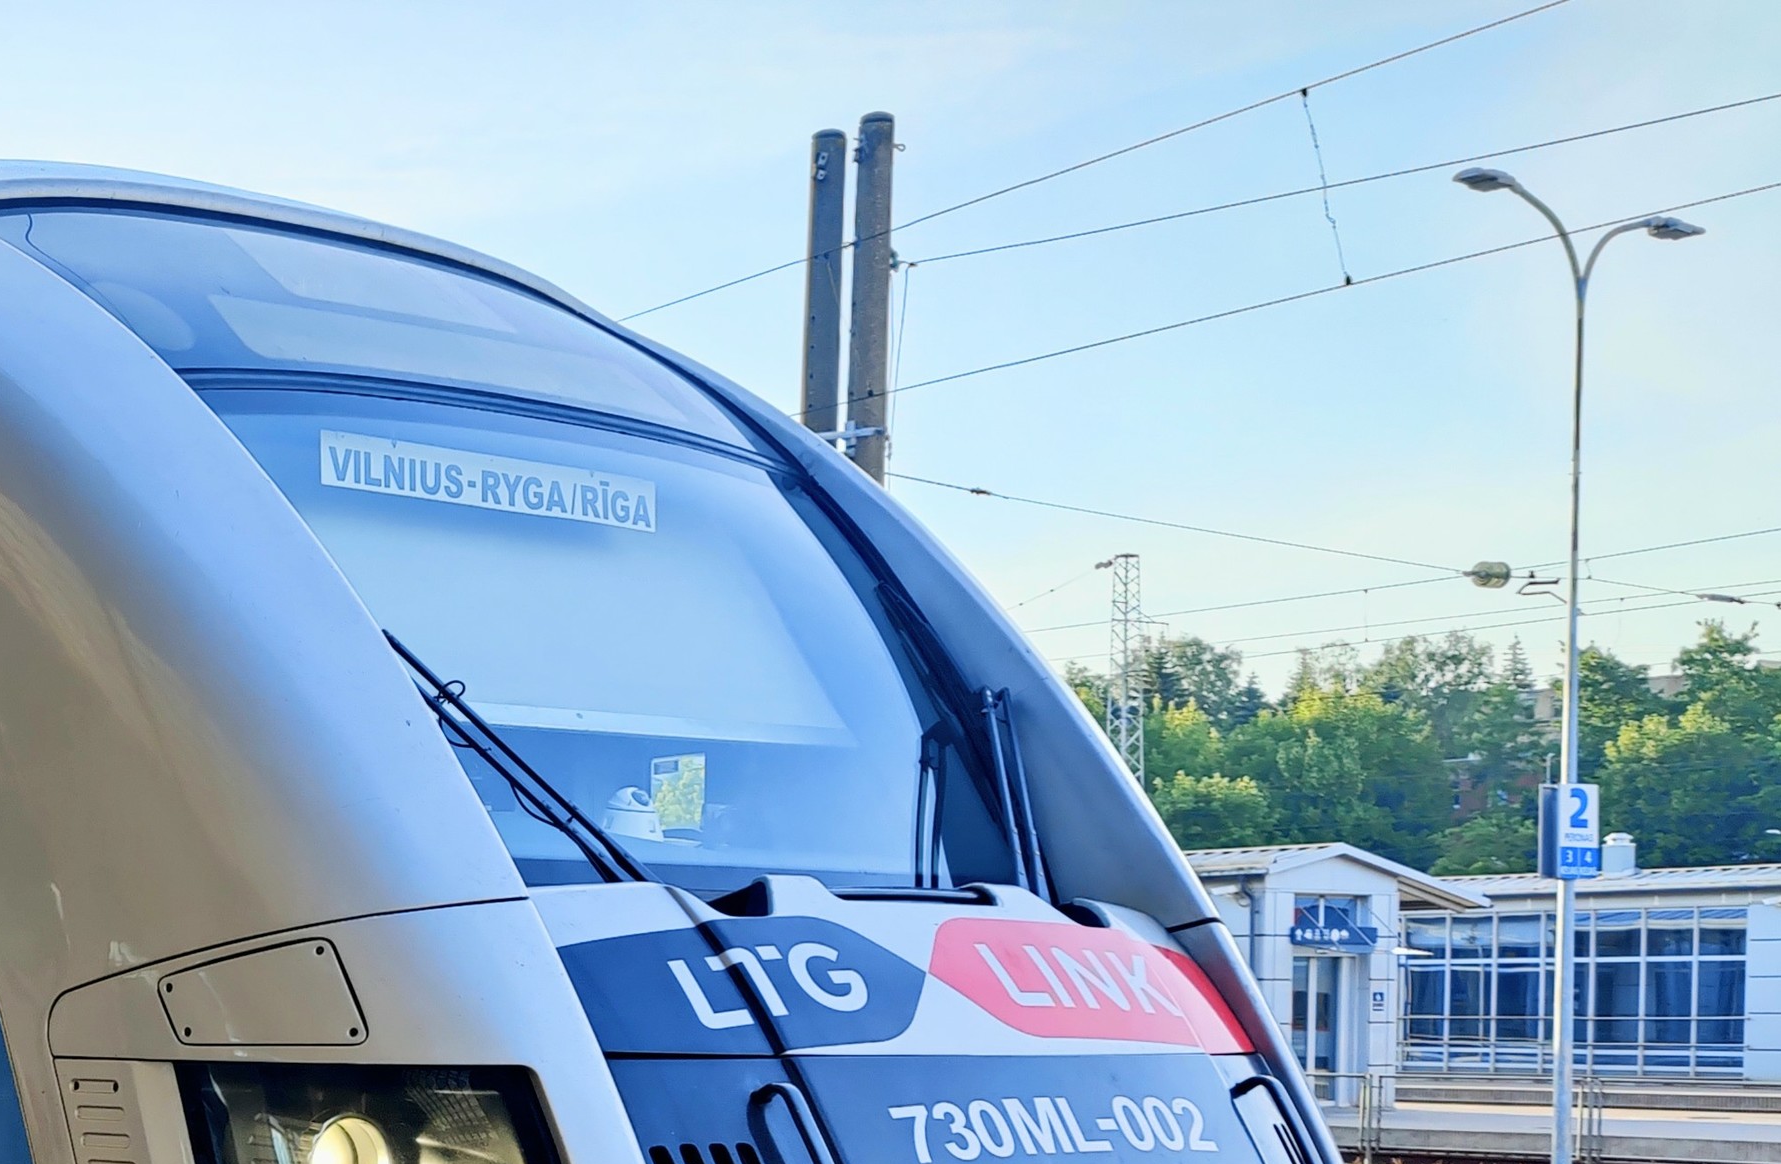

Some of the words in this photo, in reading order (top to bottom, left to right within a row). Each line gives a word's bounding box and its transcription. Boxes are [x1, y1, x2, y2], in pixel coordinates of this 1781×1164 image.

[327, 445, 653, 529] VILNIUS-RYGA/RĪGA
[1569, 787, 1588, 828] 2
[1564, 849, 1574, 863] 3
[1584, 850, 1593, 863] 4
[666, 941, 870, 1031] LTG
[973, 943, 1185, 1019] LINK
